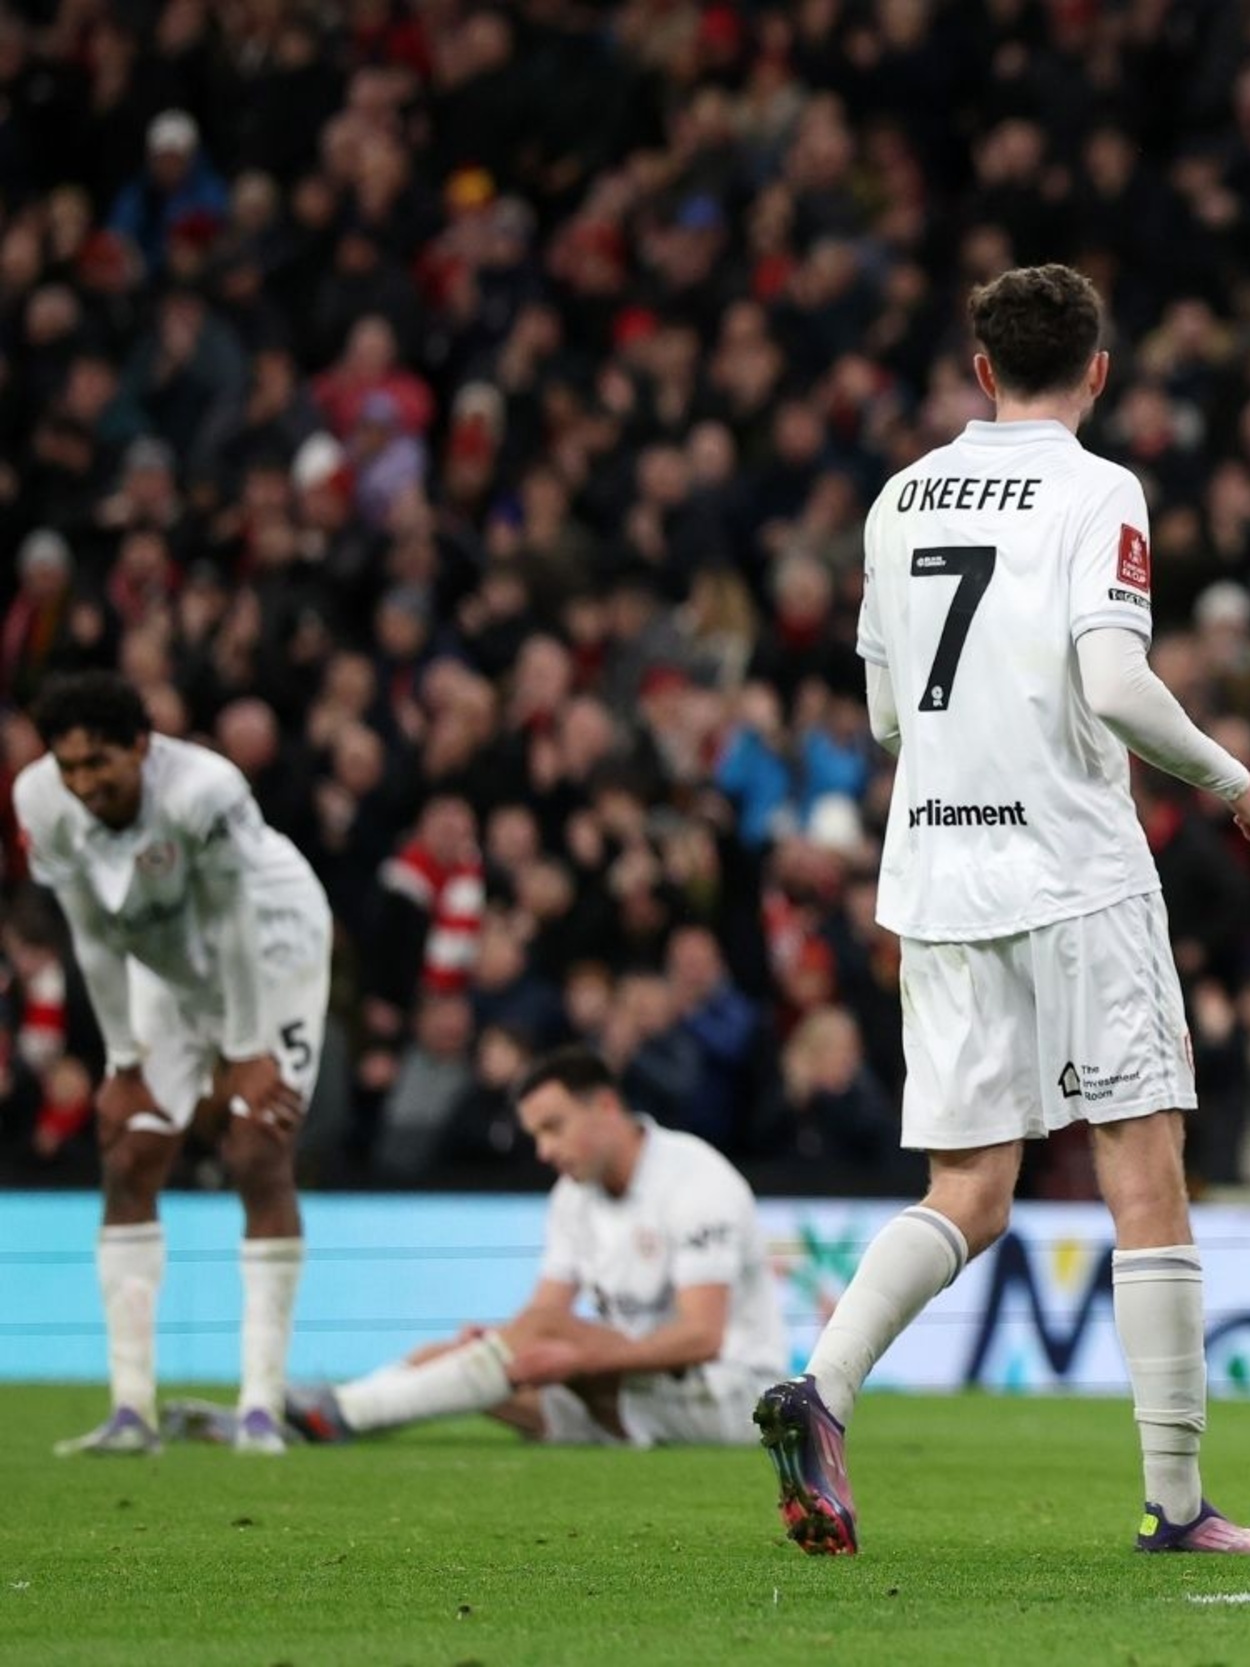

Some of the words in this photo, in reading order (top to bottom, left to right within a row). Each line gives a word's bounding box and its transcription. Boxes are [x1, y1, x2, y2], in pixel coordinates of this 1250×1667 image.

[898, 478, 1042, 512] O'KEEFFE
[911, 546, 997, 711] 7
[909, 799, 1027, 828] rliament
[280, 1021, 312, 1071] 5
[1081, 1065, 1099, 1074] The
[1084, 1089, 1113, 1101] Room
